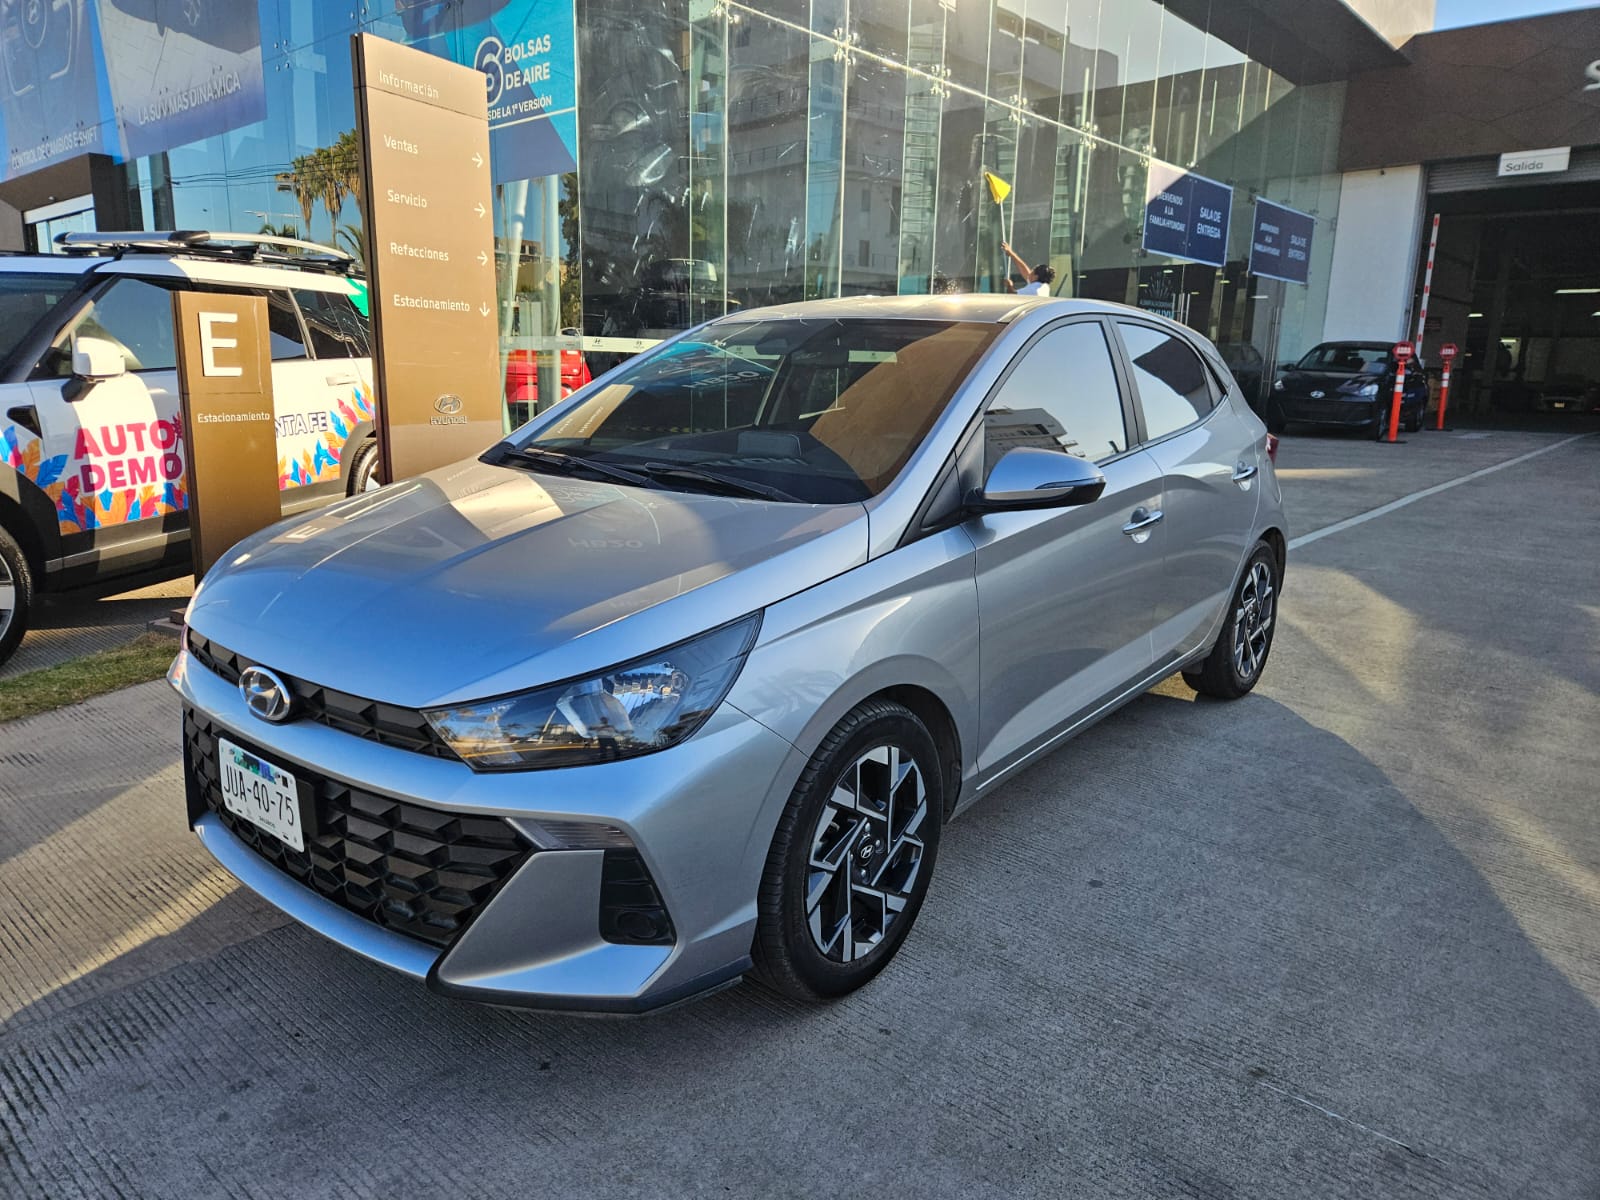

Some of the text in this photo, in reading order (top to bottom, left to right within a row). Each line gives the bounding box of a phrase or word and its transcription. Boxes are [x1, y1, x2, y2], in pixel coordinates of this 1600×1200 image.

[504, 34, 551, 64] BOLSAS
[379, 70, 440, 99] Información
[505, 62, 551, 90] DE AIRE
[138, 105, 150, 125] LA
[149, 98, 168, 121] SUV
[502, 104, 512, 117] LA
[518, 93, 552, 113] VERSIÓN
[384, 134, 418, 154] Ventas
[1505, 161, 1544, 172] Salida
[387, 188, 428, 208] Servicio
[390, 242, 449, 261] Refacciones
[394, 293, 471, 312] Estacionamiento
[199, 311, 243, 378] E
[197, 411, 271, 424] Estacionamiento
[308, 411, 329, 434] FE
[74, 419, 176, 461] AUTO
[80, 453, 183, 493] DEMO
[224, 764, 294, 826] JUA-40-75
